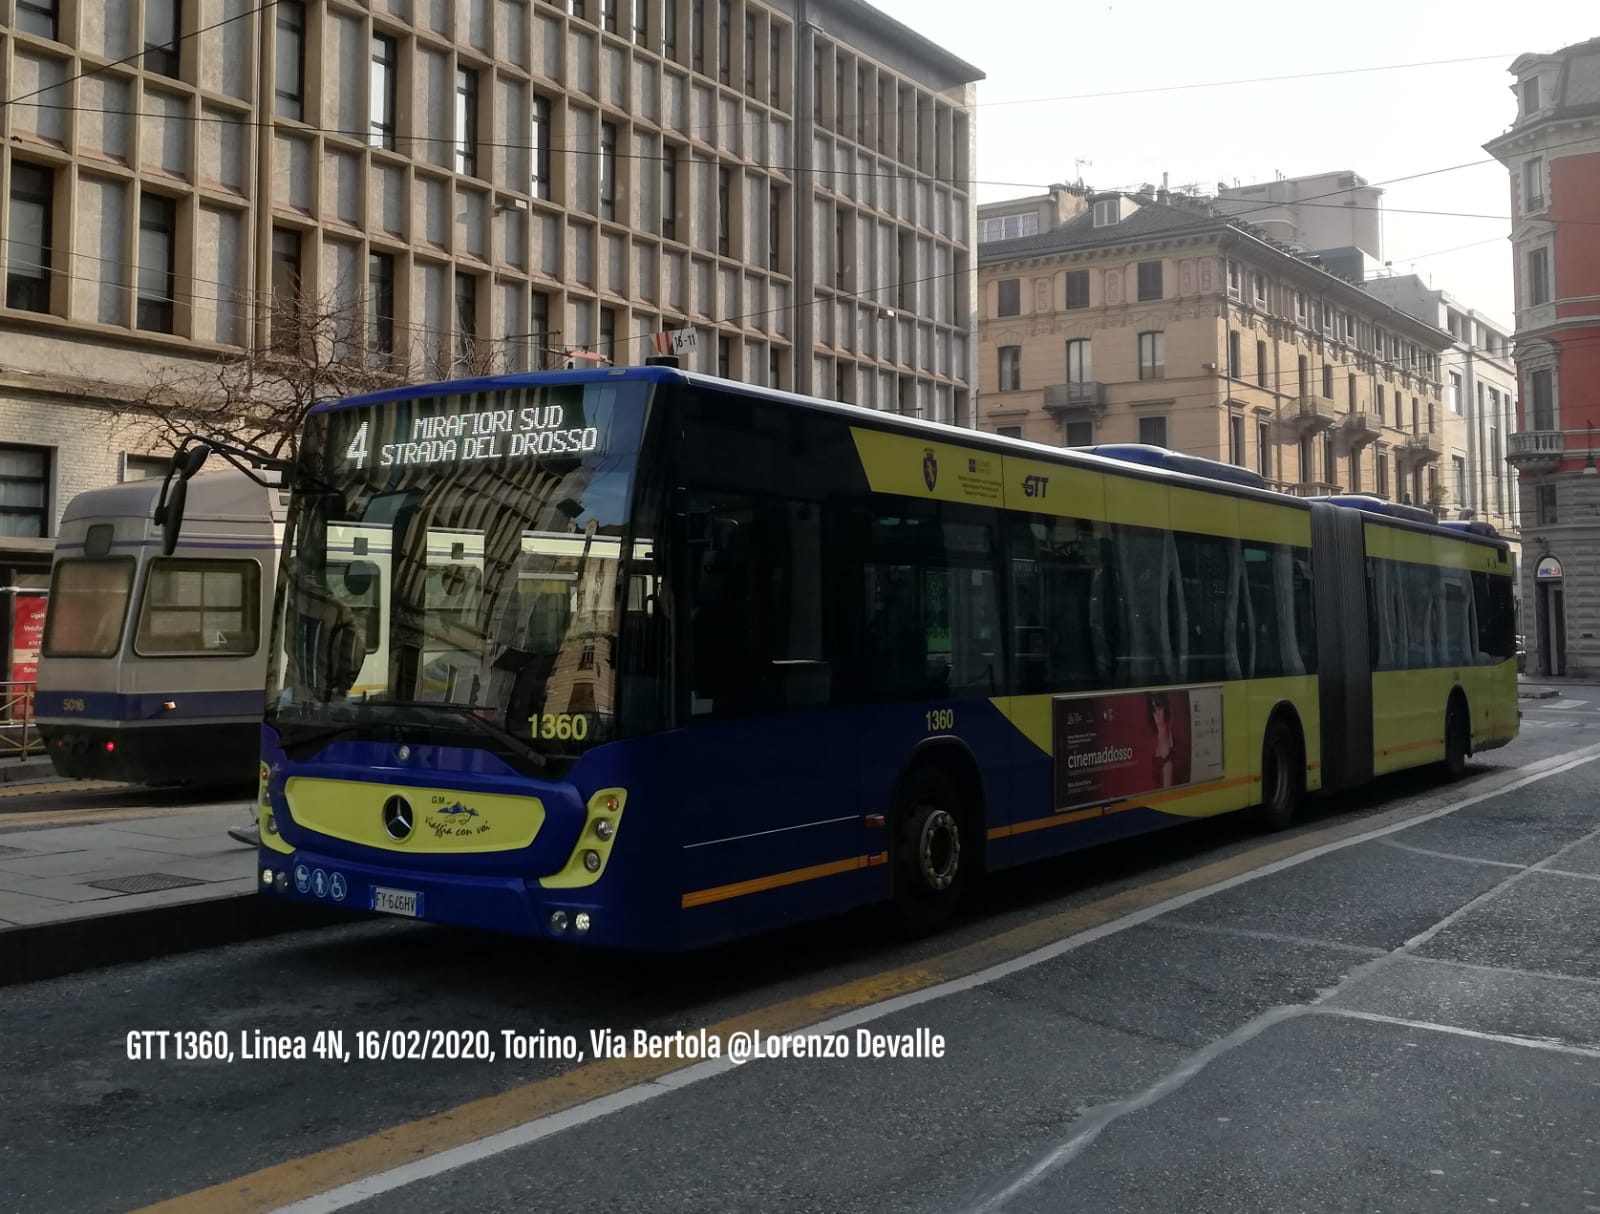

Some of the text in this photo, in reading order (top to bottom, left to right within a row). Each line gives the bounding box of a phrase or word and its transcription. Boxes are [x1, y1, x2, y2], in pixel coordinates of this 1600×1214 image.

[413, 405, 564, 440] MIRAFIORI SUD
[346, 421, 369, 469] 4
[380, 427, 598, 466] STRADA DEL DROSSO
[1022, 475, 1049, 498] GTT
[528, 713, 588, 741] 1360
[926, 709, 954, 731] 1360
[1067, 745, 1133, 769] cinemaddosso
[456, 828, 473, 837] con
